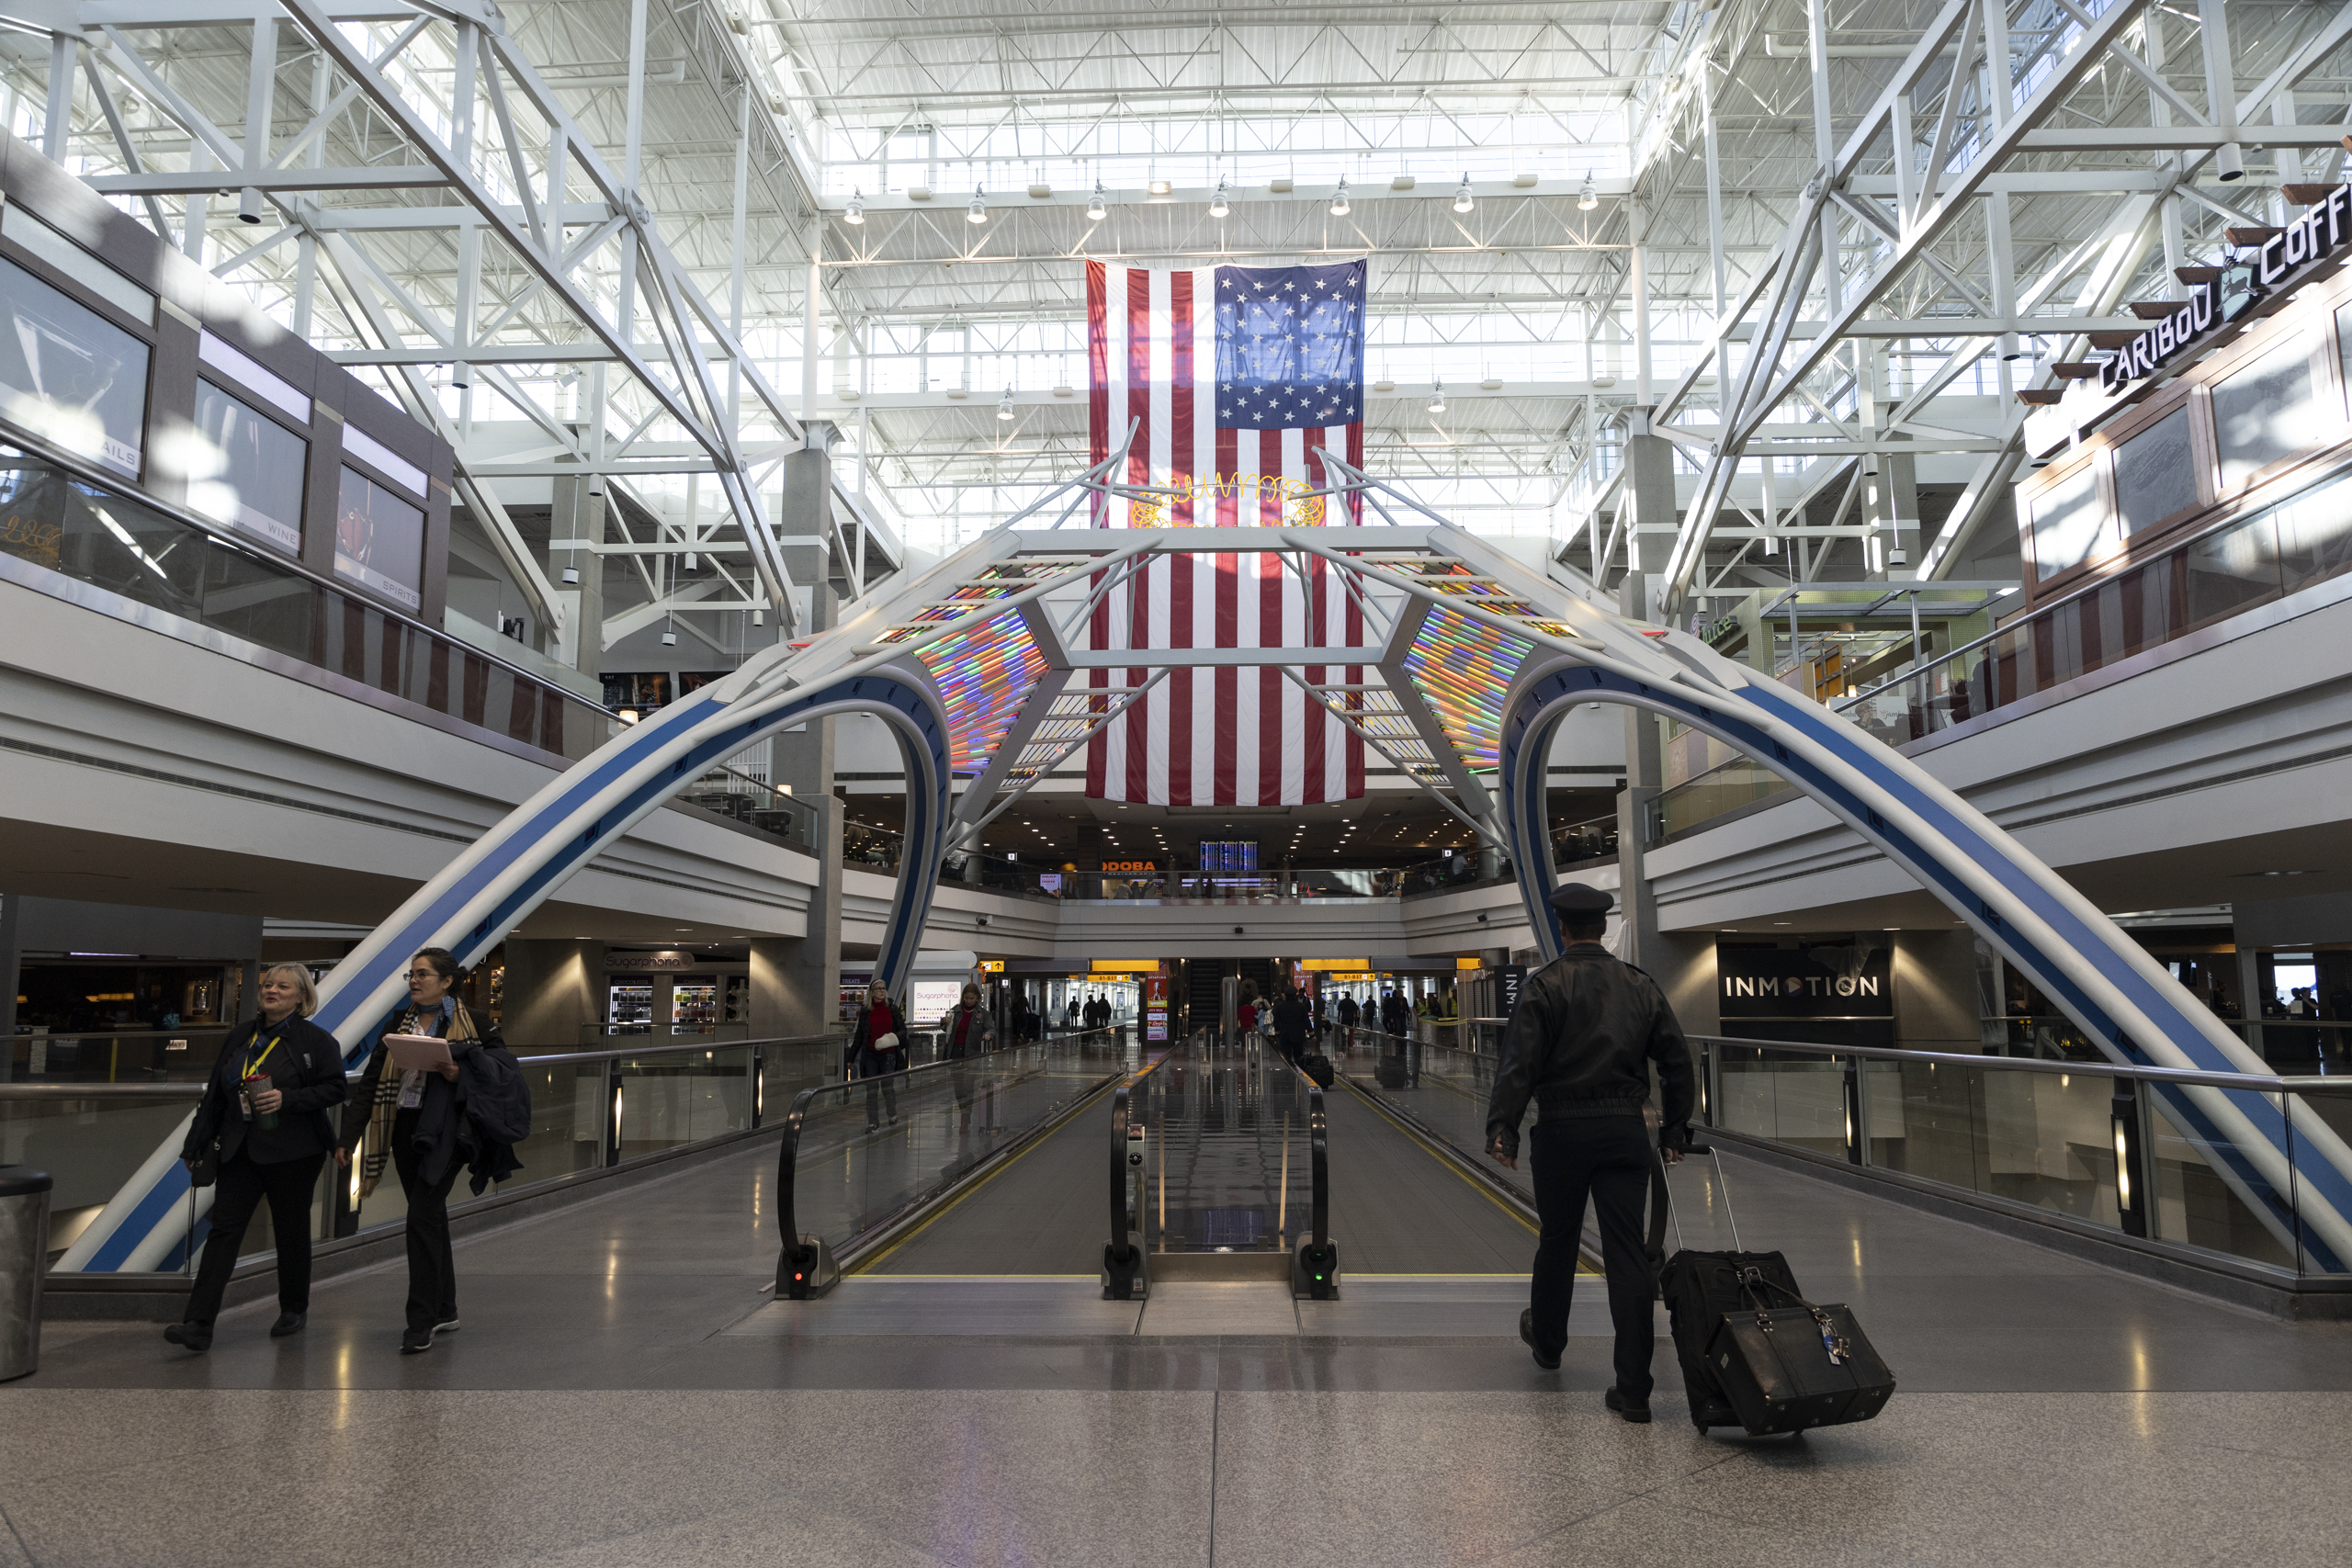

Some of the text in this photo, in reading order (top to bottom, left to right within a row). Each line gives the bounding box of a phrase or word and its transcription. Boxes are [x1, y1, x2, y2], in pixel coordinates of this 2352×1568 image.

[2098, 183, 2352, 398] CARIBOU COFF
[267, 522, 297, 545] WINE
[382, 581, 418, 604] SPIRITS
